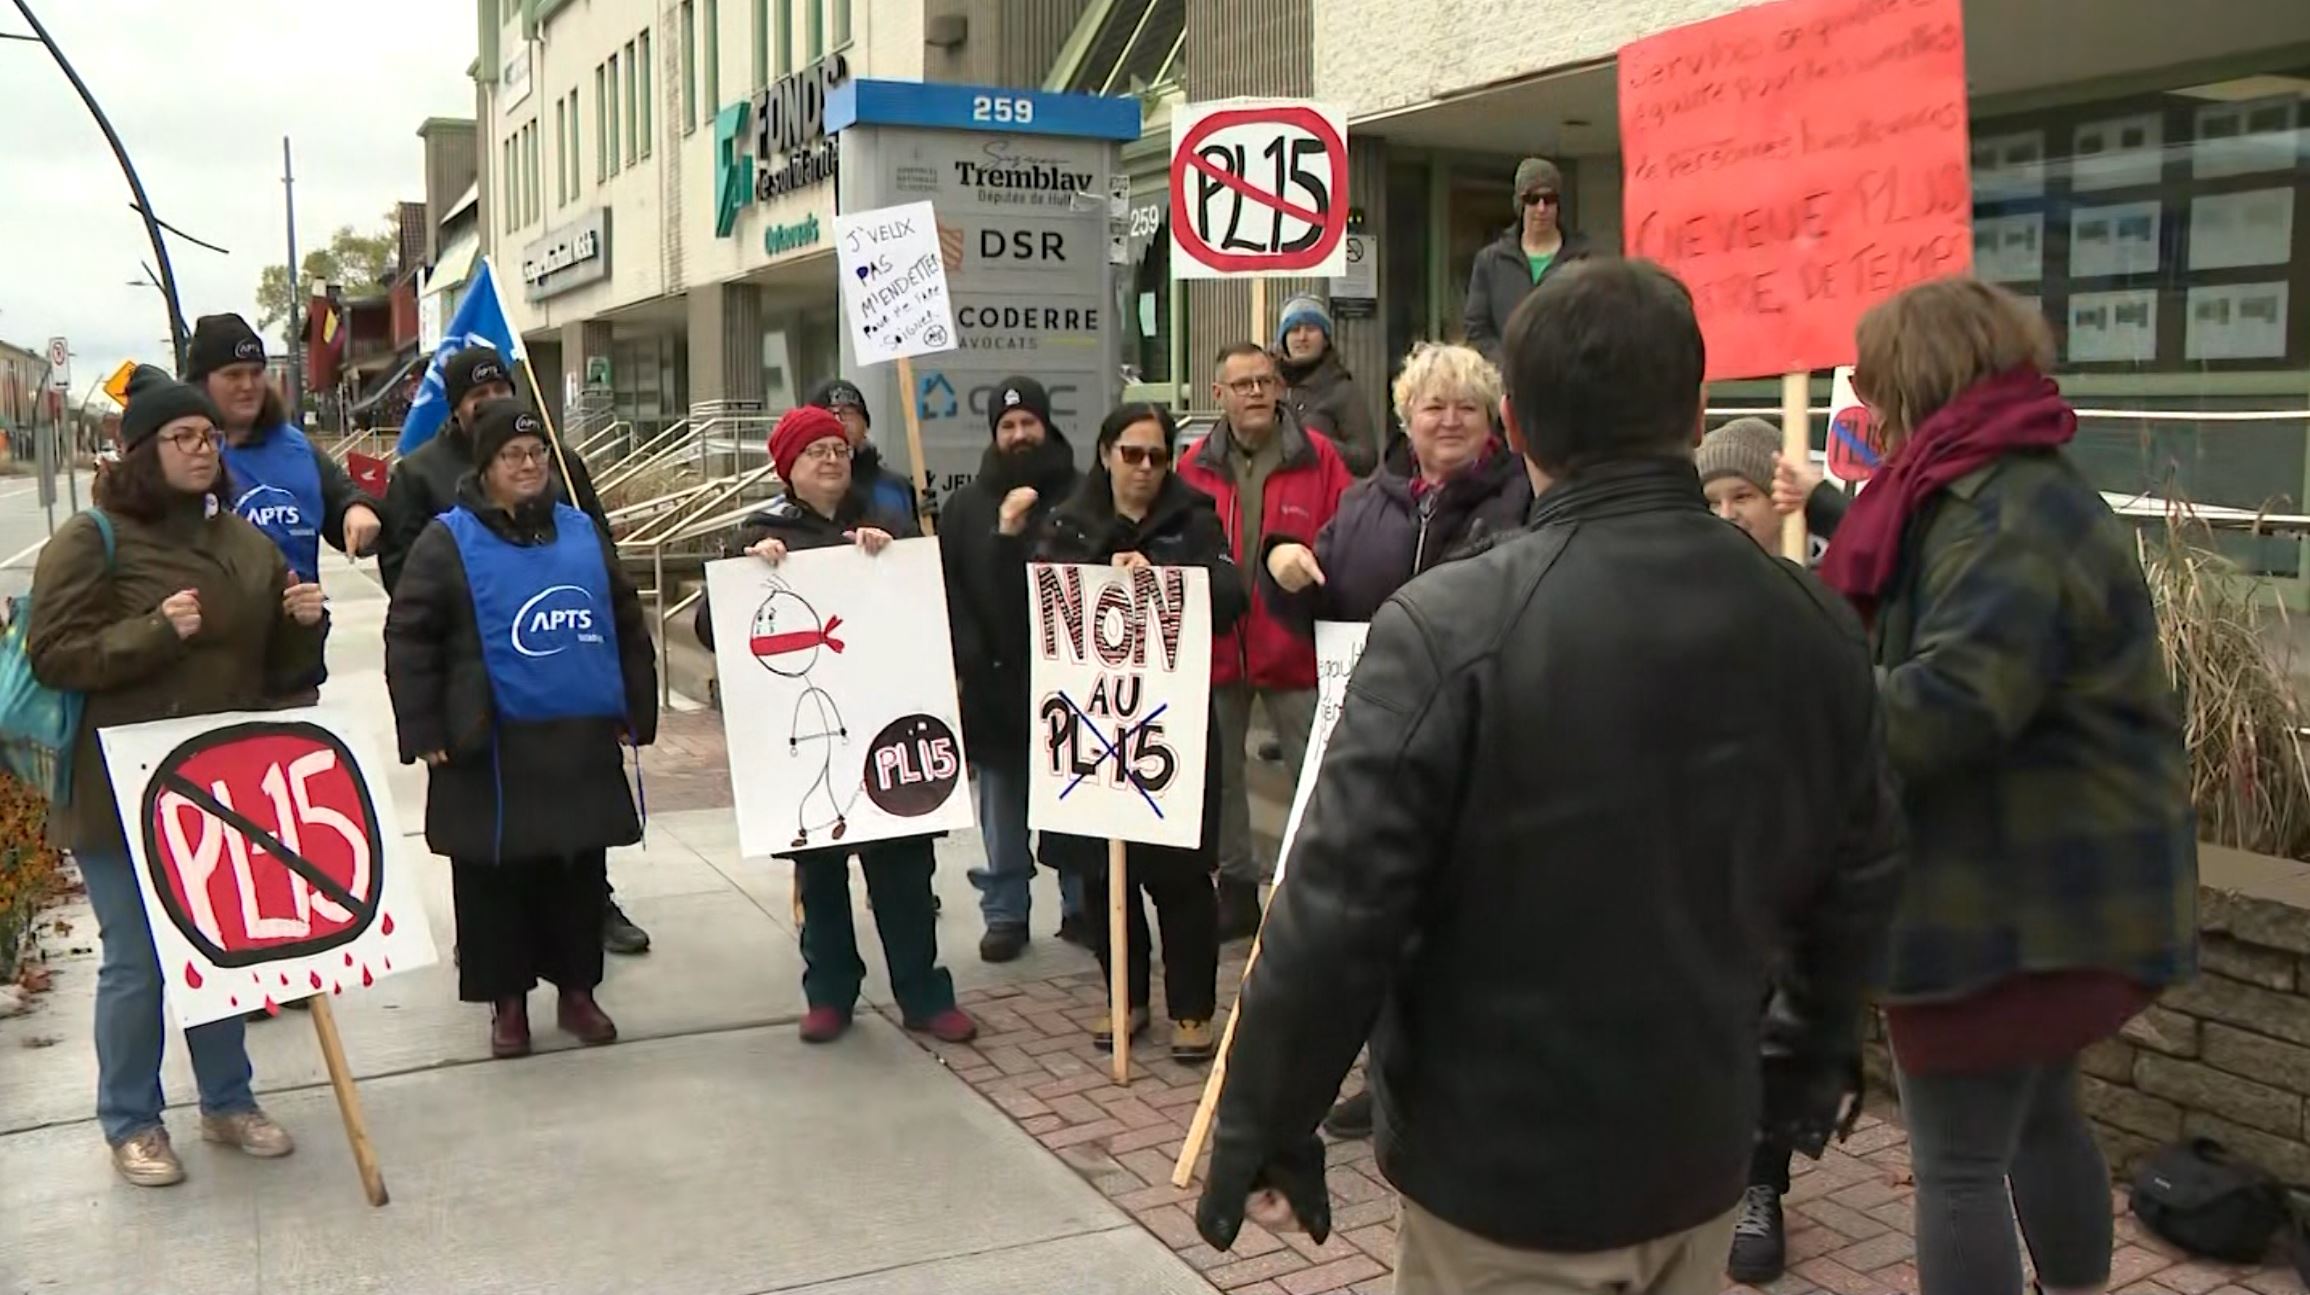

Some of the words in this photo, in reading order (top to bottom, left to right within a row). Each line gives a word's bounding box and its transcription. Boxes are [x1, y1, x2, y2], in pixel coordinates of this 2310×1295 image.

[973, 96, 1033, 123] 259
[954, 161, 1094, 192] Tremblay
[1197, 135, 1329, 253] PL15
[1129, 204, 1160, 237] 259
[980, 229, 1067, 262] DSR
[856, 254, 893, 287] PAS
[958, 306, 1100, 332] CODERRE
[958, 336, 1039, 350] AVOCATS
[246, 504, 301, 526] APTS
[529, 608, 593, 633] APTS
[1037, 565, 1188, 672] NON
[1086, 671, 1143, 719] AU
